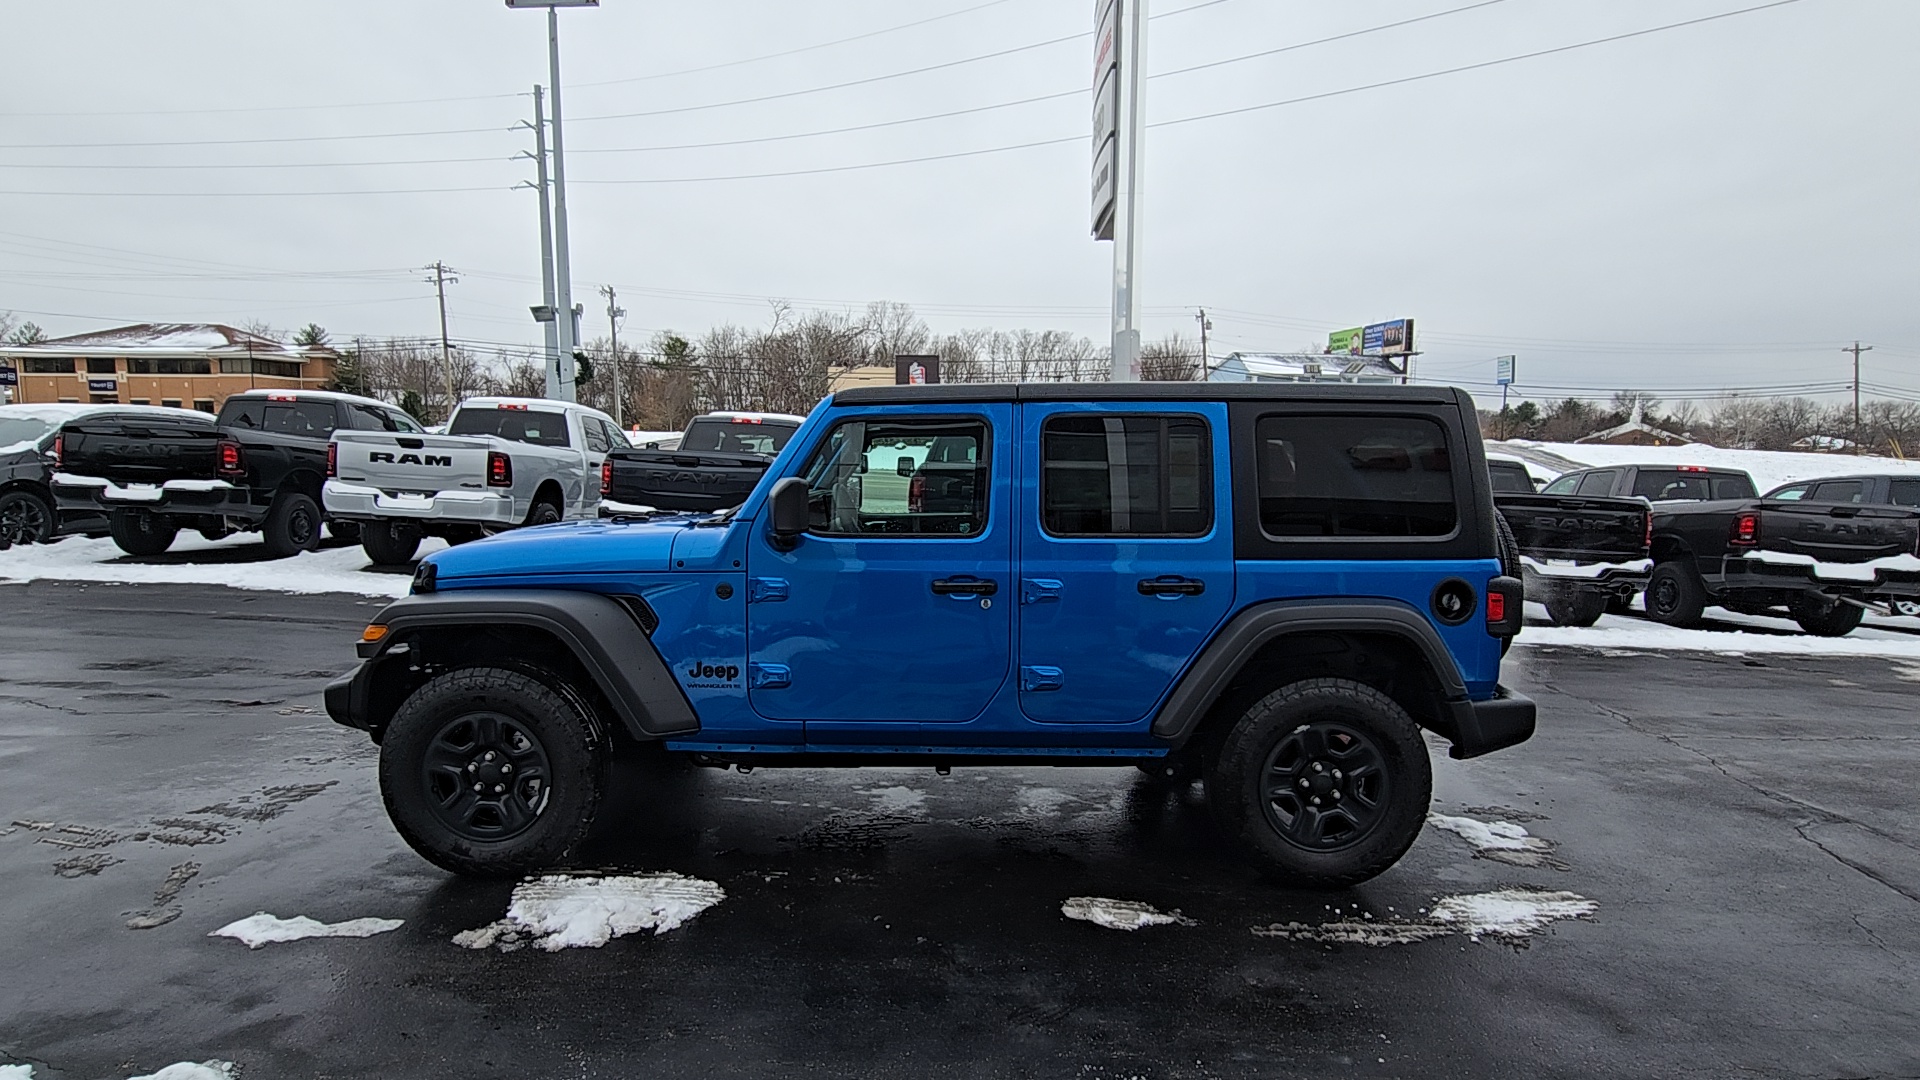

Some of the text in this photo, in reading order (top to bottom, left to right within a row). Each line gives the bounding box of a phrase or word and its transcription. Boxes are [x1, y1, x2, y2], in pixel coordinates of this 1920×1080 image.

[101, 443, 180, 456] RAM
[369, 451, 452, 467] RAM
[647, 469, 727, 484] RAM
[1534, 516, 1607, 530] RAM
[1800, 522, 1885, 535] RAM
[688, 660, 740, 682] Jeep
